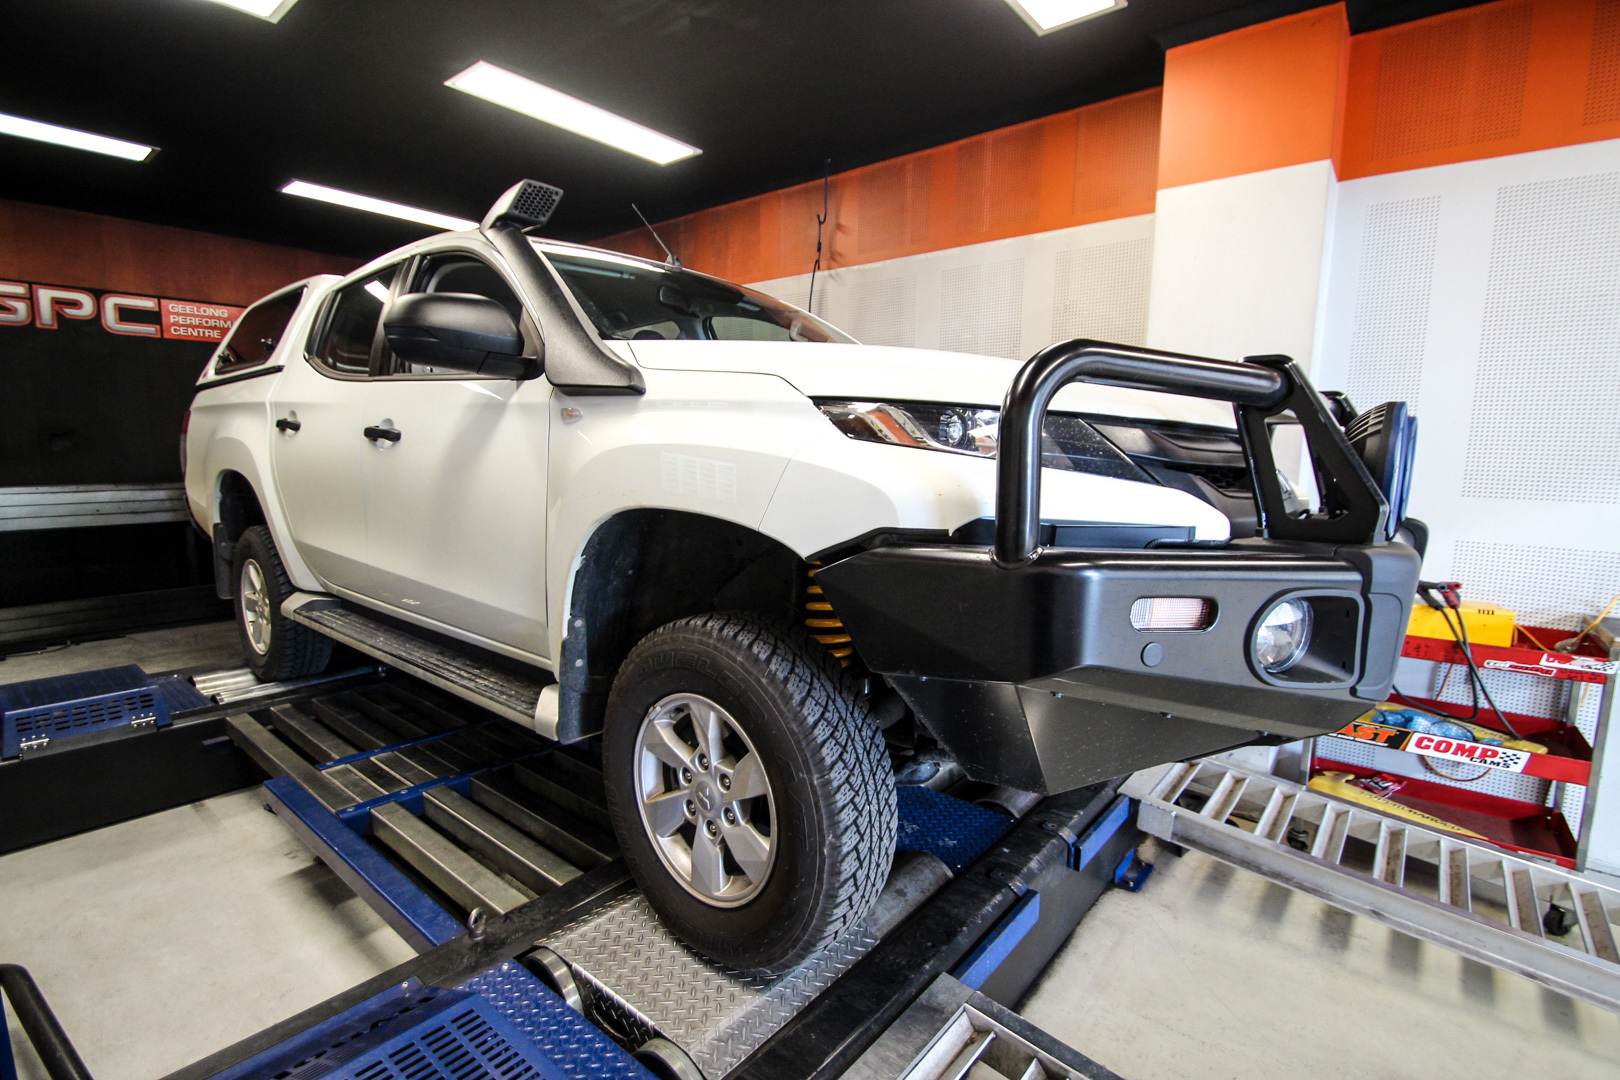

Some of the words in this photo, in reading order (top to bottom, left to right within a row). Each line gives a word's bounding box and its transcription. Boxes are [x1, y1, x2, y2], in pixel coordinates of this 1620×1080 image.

[168, 303, 229, 318] GEELONG
[169, 315, 235, 329] PERFORM
[170, 326, 222, 339] CENTRE
[1414, 736, 1500, 760] COMP
[1469, 756, 1512, 769] CAMS
